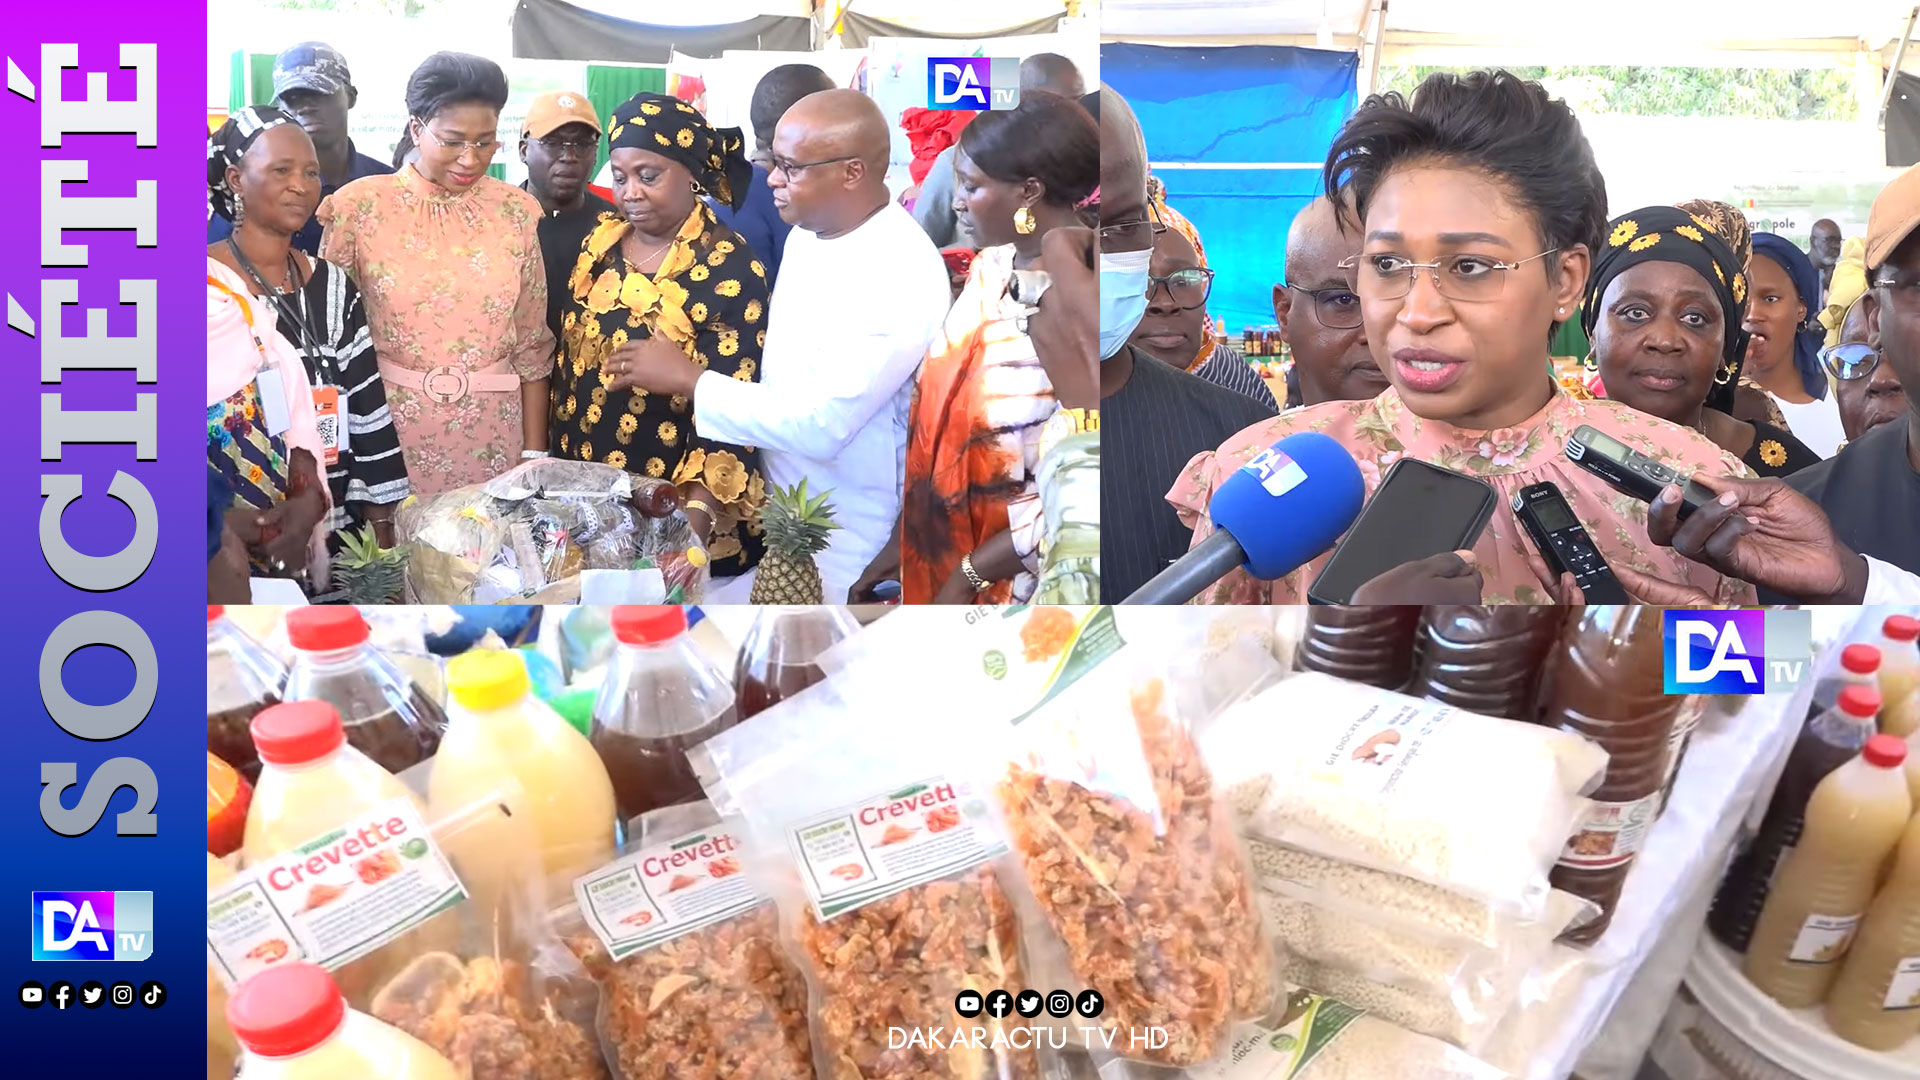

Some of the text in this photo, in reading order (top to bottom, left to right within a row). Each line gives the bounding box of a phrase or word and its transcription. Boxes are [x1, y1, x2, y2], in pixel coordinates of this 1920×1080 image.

[1530, 489, 1549, 499] SONY
[965, 606, 989, 625] GIE
[267, 815, 408, 892] Crevette
[643, 834, 739, 878] Crevett
